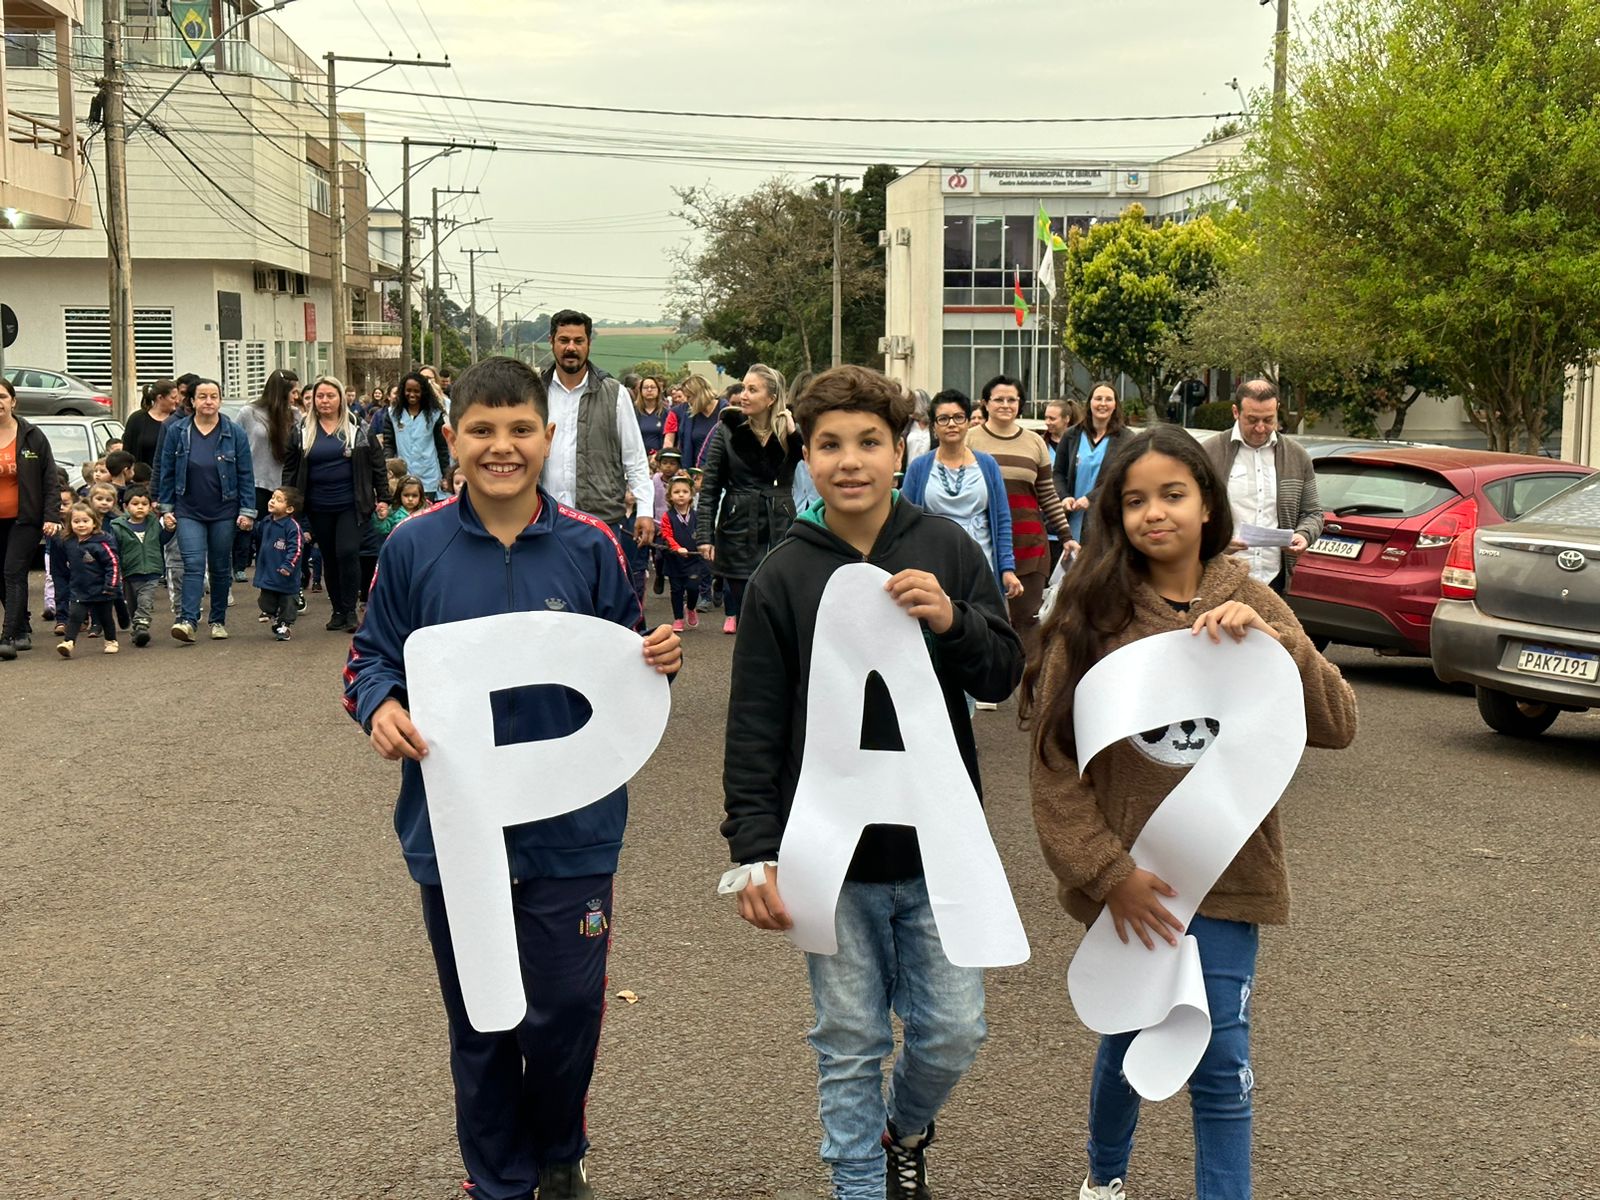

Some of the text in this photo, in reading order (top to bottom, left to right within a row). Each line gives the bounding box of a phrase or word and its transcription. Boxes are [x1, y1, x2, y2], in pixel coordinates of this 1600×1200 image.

[989, 170, 1028, 178] PREFEITURA
[1029, 170, 1065, 178] MUNICIPAL
[1066, 170, 1074, 178] DE
[1310, 539, 1354, 555] XX3A96
[1524, 652, 1588, 677] PAK7I91
[404, 610, 671, 1033] P
[777, 562, 1030, 968] A
